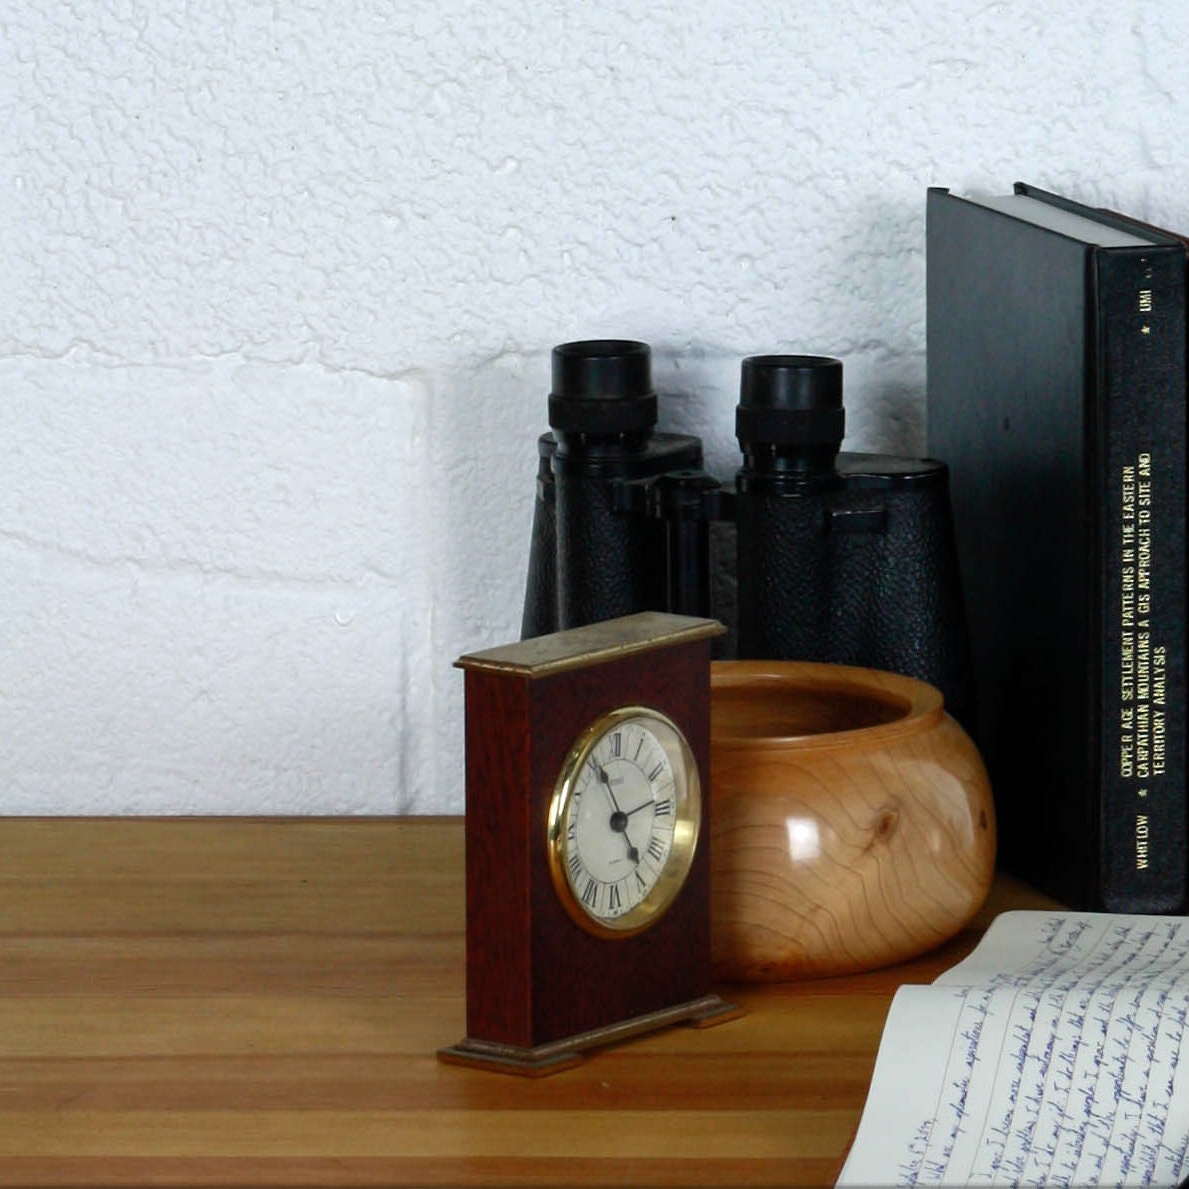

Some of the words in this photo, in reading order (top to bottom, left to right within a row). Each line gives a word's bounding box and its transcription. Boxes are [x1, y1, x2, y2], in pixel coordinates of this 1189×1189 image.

[1139, 289, 1152, 312] UMI
[1138, 452, 1151, 476] AND
[1122, 466, 1135, 519] EASTERN
[1138, 481, 1151, 506] SITE
[1138, 510, 1151, 526] TO
[1122, 523, 1135, 545] THE
[1122, 549, 1135, 562] IN
[1138, 528, 1151, 589] APPROACH
[1122, 566, 1135, 626] PATTERNS
[1138, 593, 1150, 613] GIS
[1138, 619, 1150, 627] A
[1121, 631, 1135, 701] SETTLEMENT
[1137, 631, 1150, 700] MOUNTAINS
[1153, 646, 1166, 705] ANALYSIS
[1121, 707, 1134, 730] AGE
[1137, 704, 1150, 779] CARPATHIAN
[1153, 710, 1166, 776] TERRITORY
[1121, 734, 1134, 778] COPPER
[648, 762, 664, 782] II
[655, 800, 670, 817] III
[1136, 815, 1149, 870] WHITLOW
